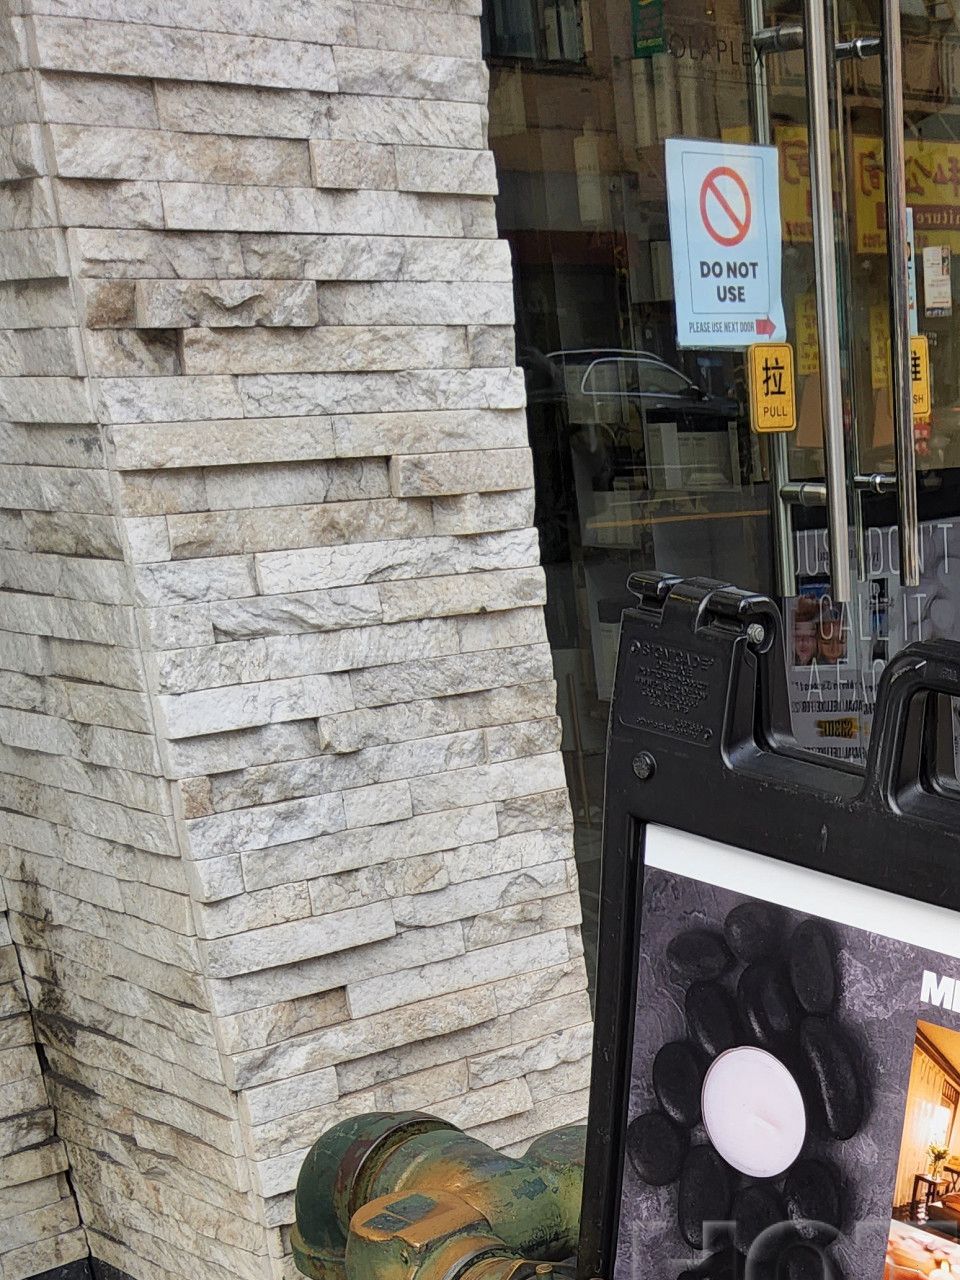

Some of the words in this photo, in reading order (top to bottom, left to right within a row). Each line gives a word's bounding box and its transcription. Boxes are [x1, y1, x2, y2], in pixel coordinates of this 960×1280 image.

[700, 261, 723, 279] DO
[726, 261, 758, 280] NOT
[716, 285, 746, 303] USE
[689, 320, 711, 334] PLEASE
[711, 320, 723, 333] USE
[723, 320, 740, 333] NEXT
[740, 320, 755, 333] DOOR
[762, 357, 786, 397] 拉
[763, 406, 788, 418] PULL
